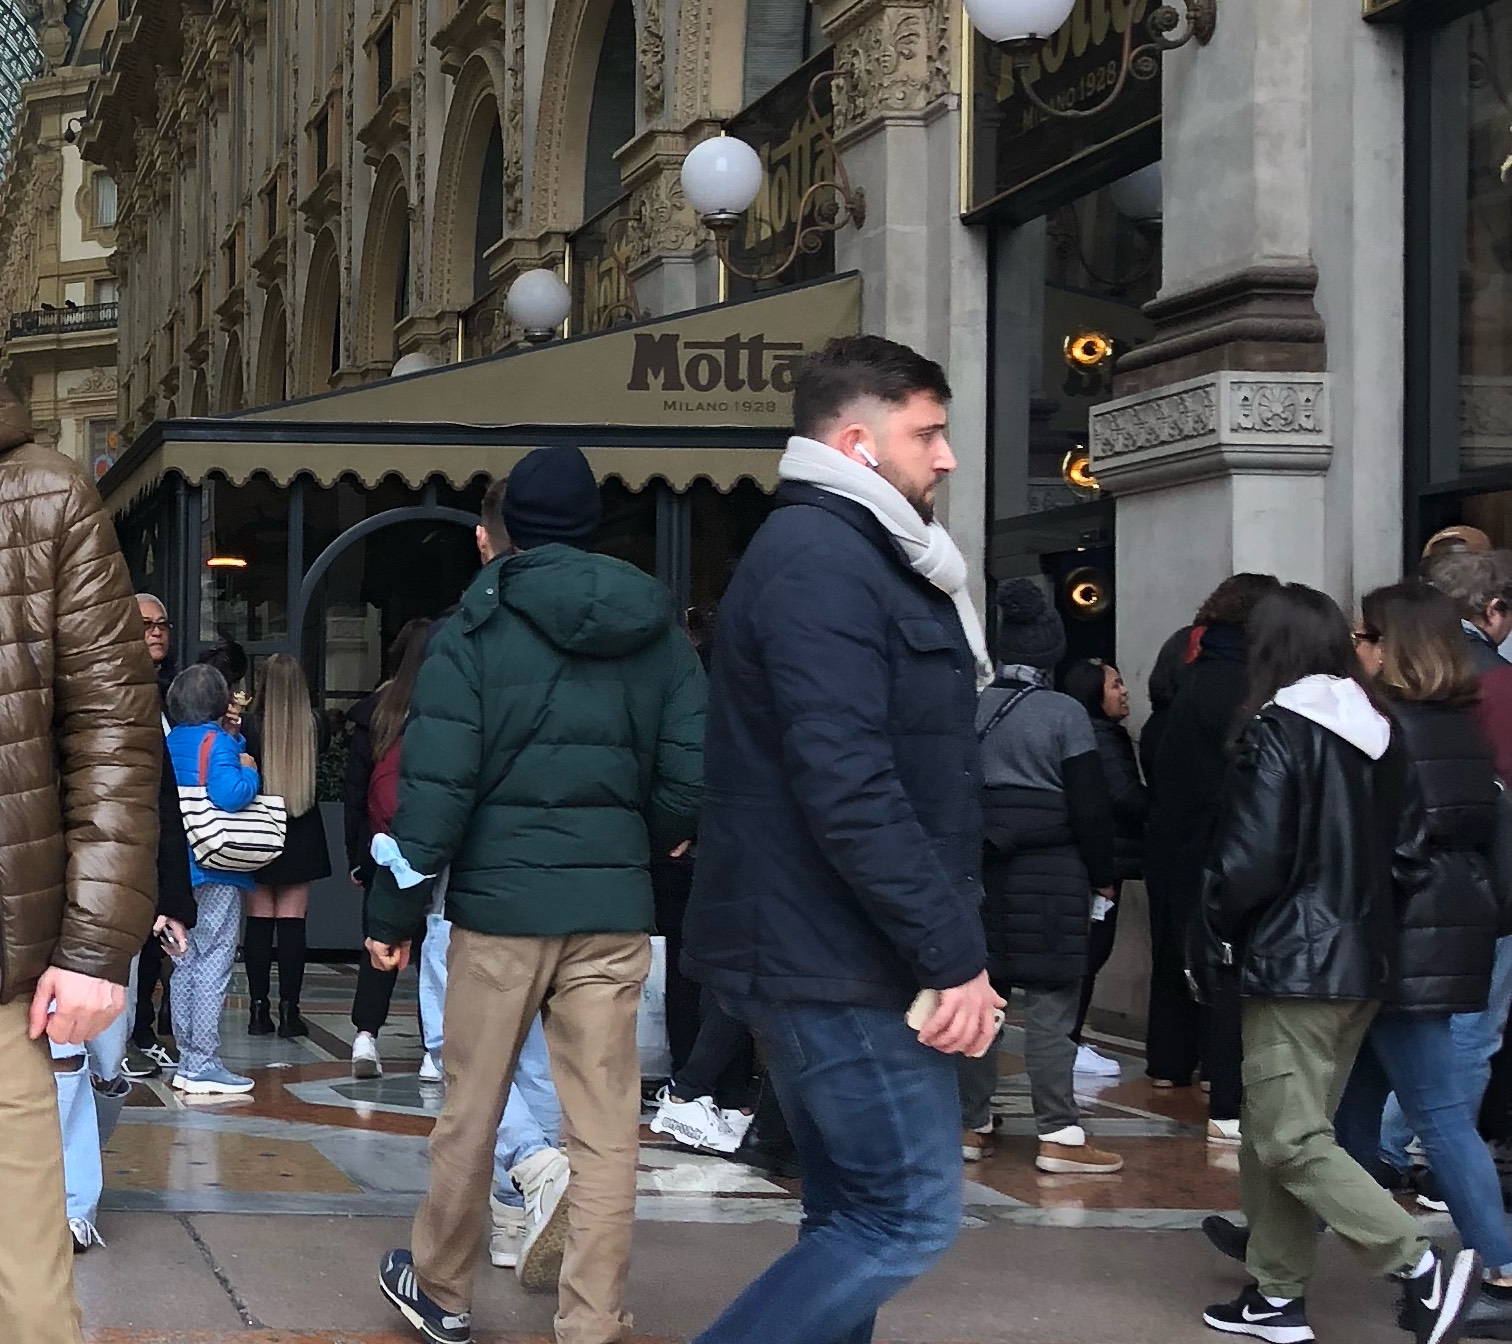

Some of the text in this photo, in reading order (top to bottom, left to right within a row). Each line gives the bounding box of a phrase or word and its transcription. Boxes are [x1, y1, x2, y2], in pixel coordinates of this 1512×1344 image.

[1080, 60, 1117, 100] 1928
[627, 333, 803, 394] Motta
[734, 400, 777, 413] 1928
